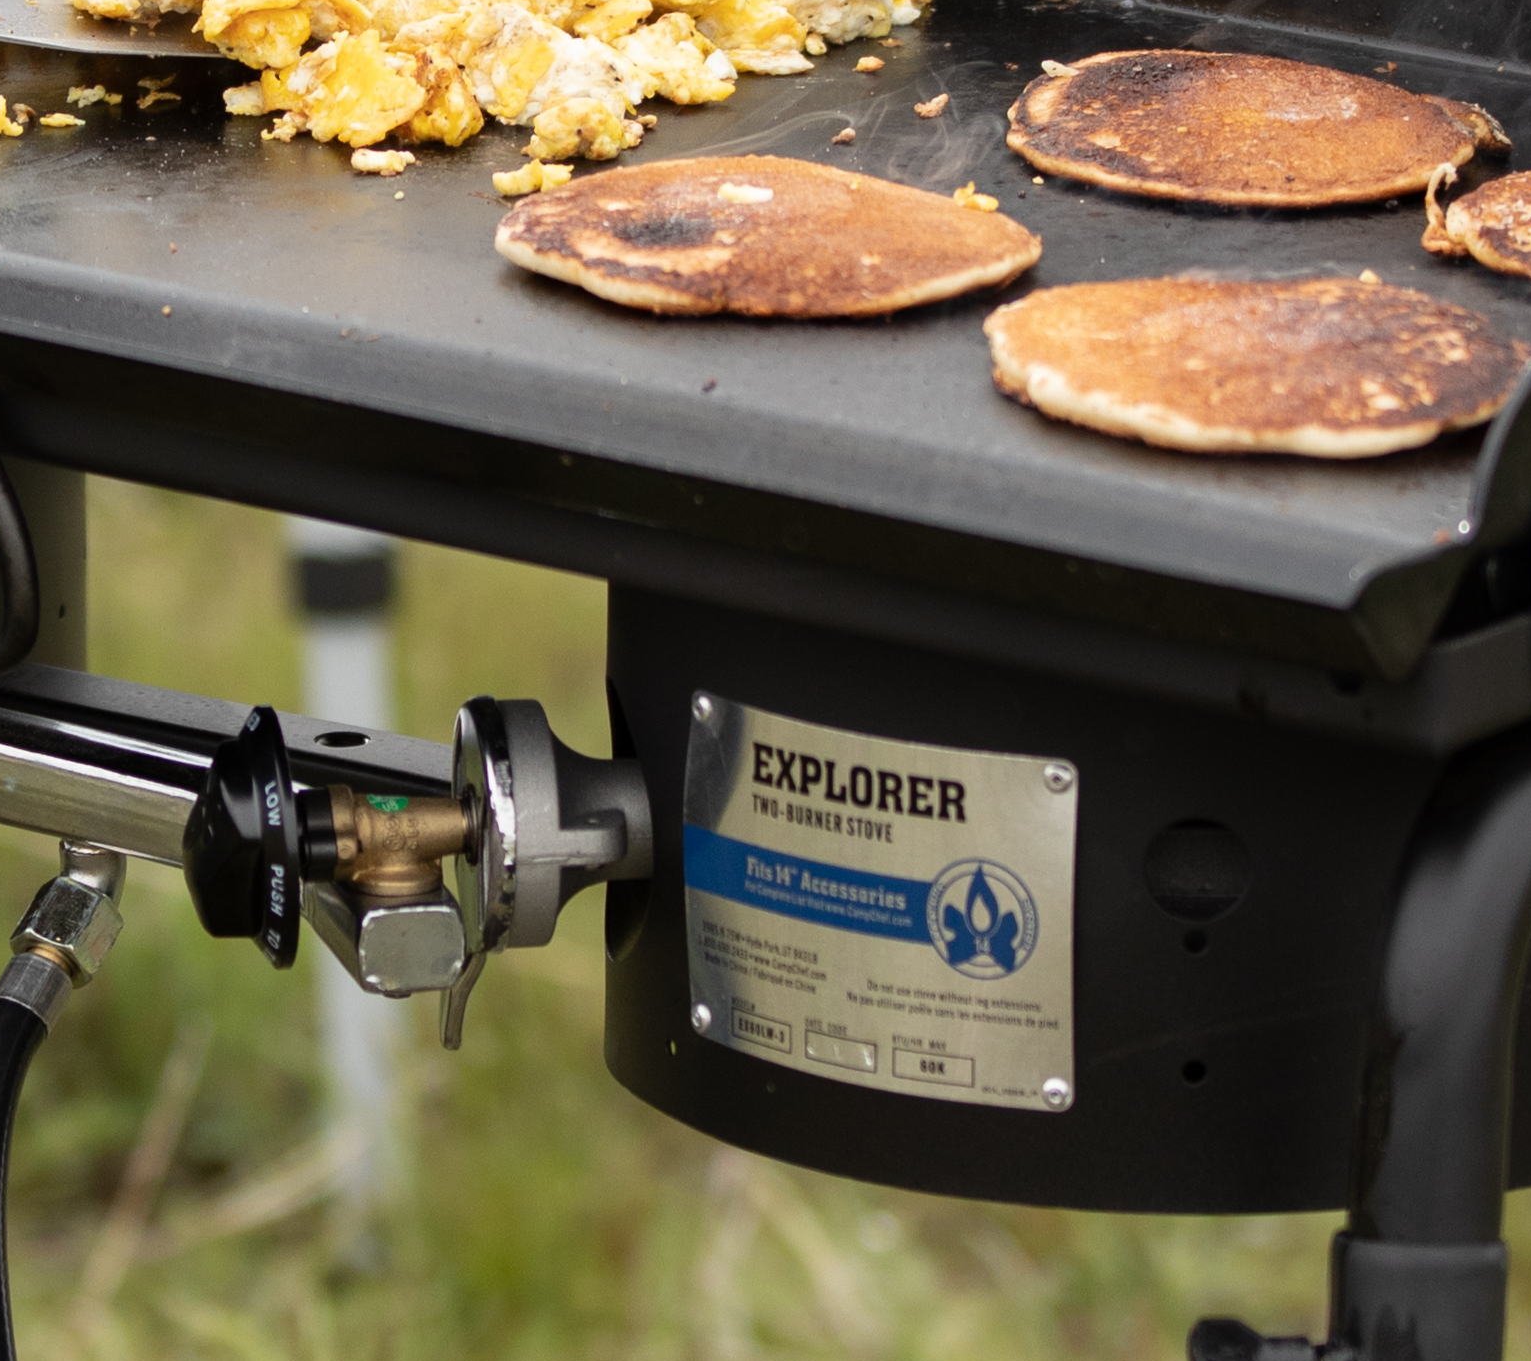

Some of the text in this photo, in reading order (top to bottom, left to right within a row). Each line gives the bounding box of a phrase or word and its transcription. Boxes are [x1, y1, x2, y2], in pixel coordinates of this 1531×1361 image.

[264, 780, 281, 827] LOW
[753, 742, 966, 824] EXPLORER
[752, 793, 893, 843] TWO-BURNER STOVE
[270, 863, 285, 917] PUSH
[746, 855, 773, 882] Fits
[800, 870, 907, 911] Accessories
[267, 928, 281, 950] TO
